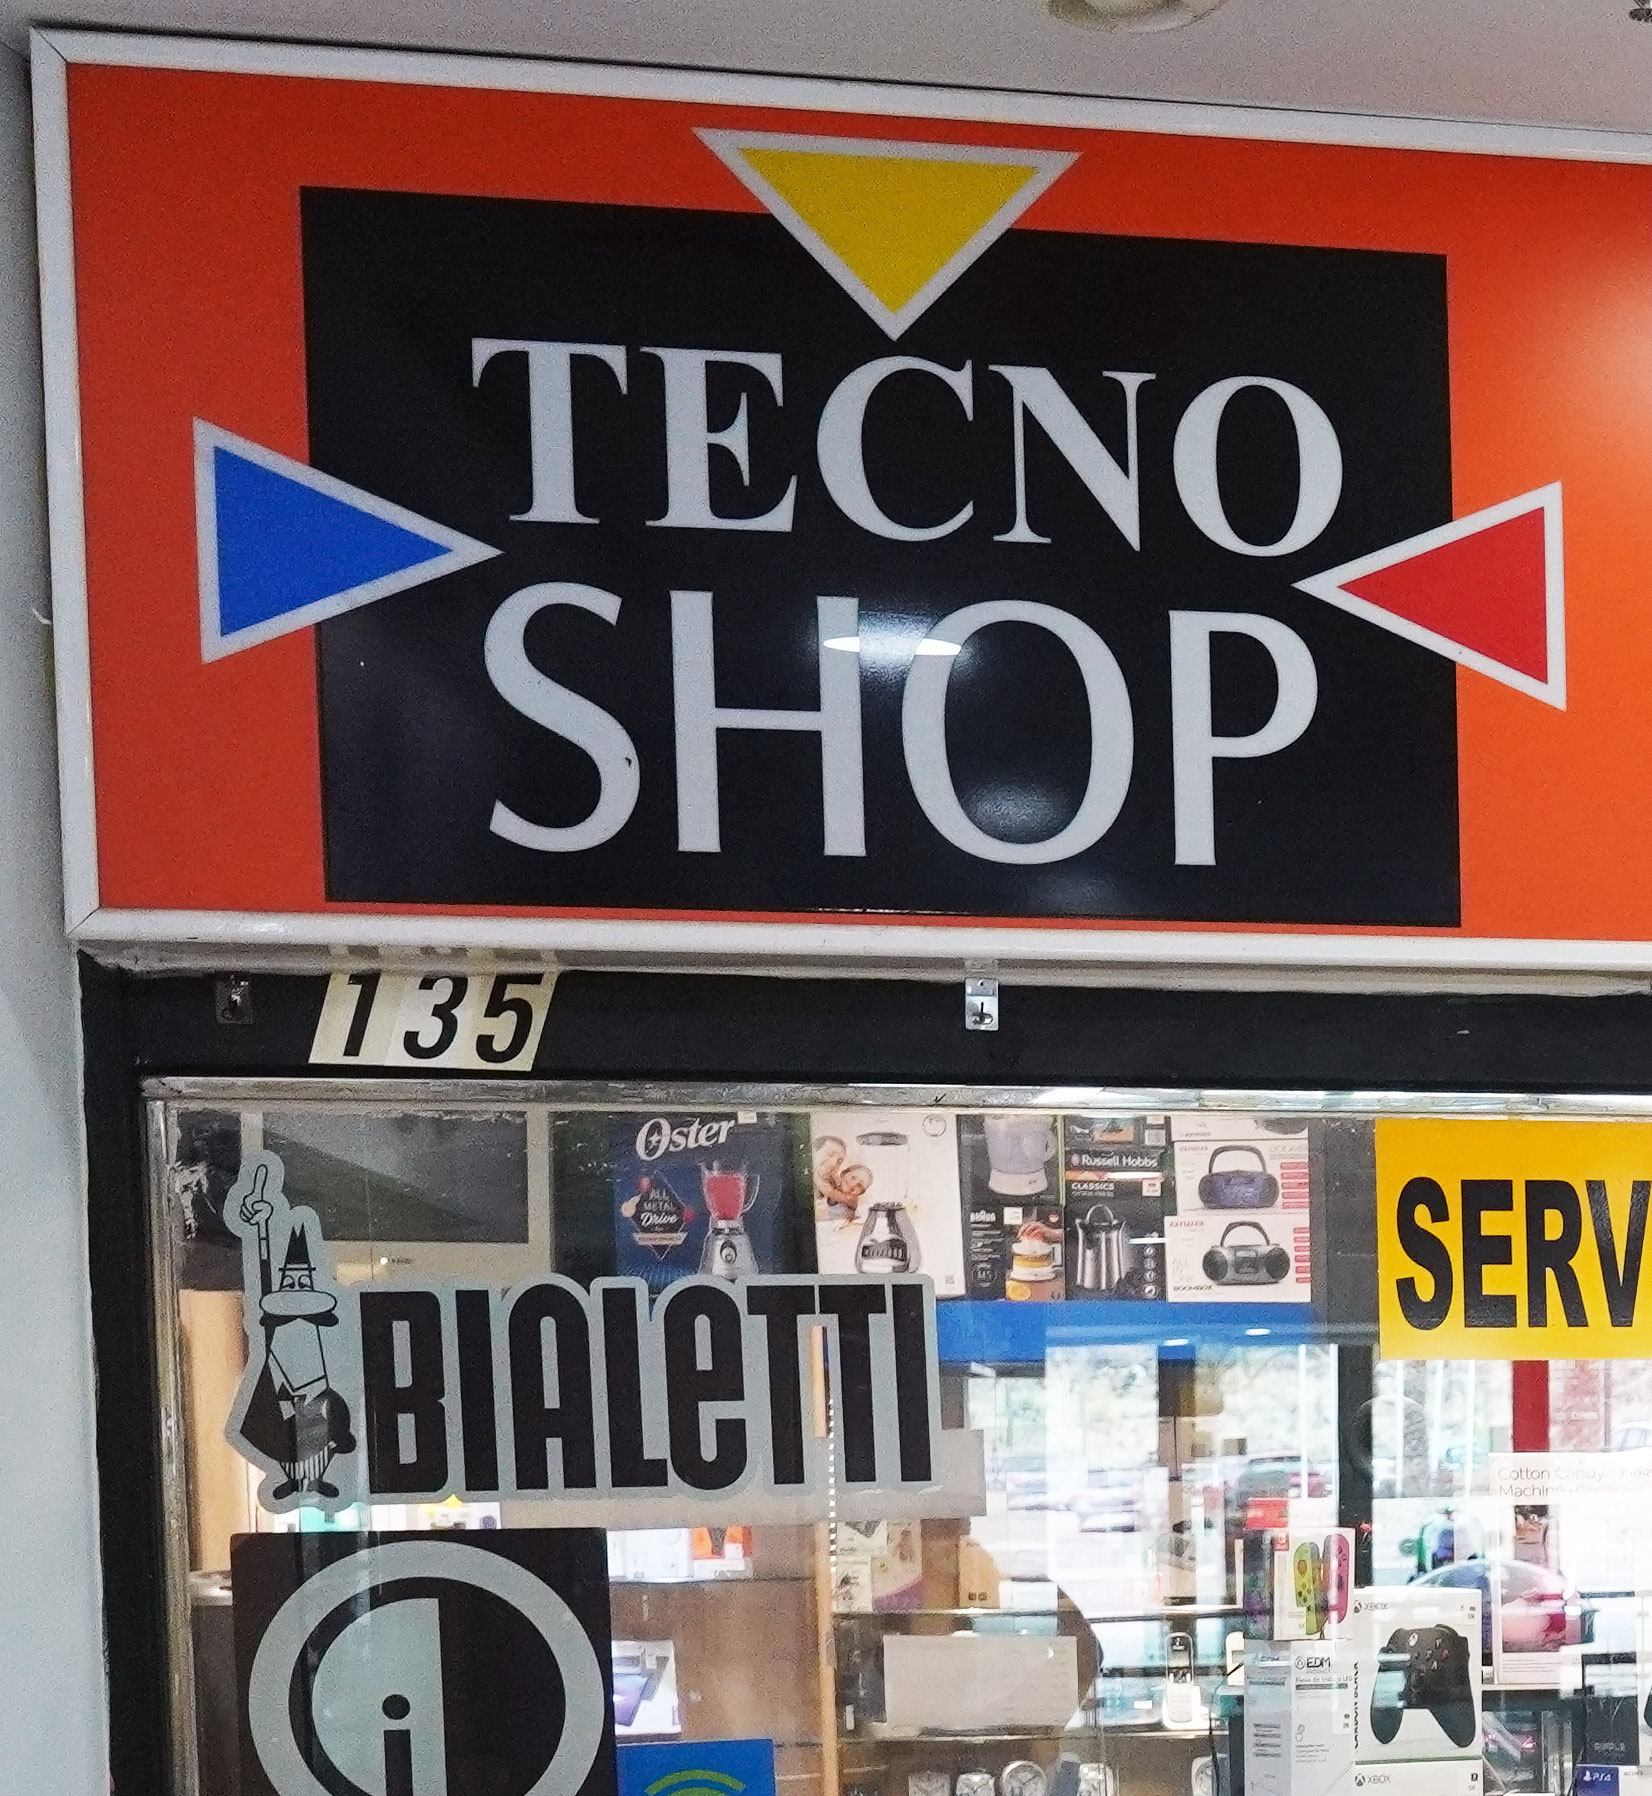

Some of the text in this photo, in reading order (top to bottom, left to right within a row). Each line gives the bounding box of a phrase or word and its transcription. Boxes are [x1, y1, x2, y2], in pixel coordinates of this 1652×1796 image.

[472, 338, 1343, 557] TECNO
[487, 580, 1317, 865] SHOP
[338, 969, 547, 1065] 135
[635, 1117, 735, 1159] Oster
[1080, 1153, 1159, 1169] Russell Hobbs
